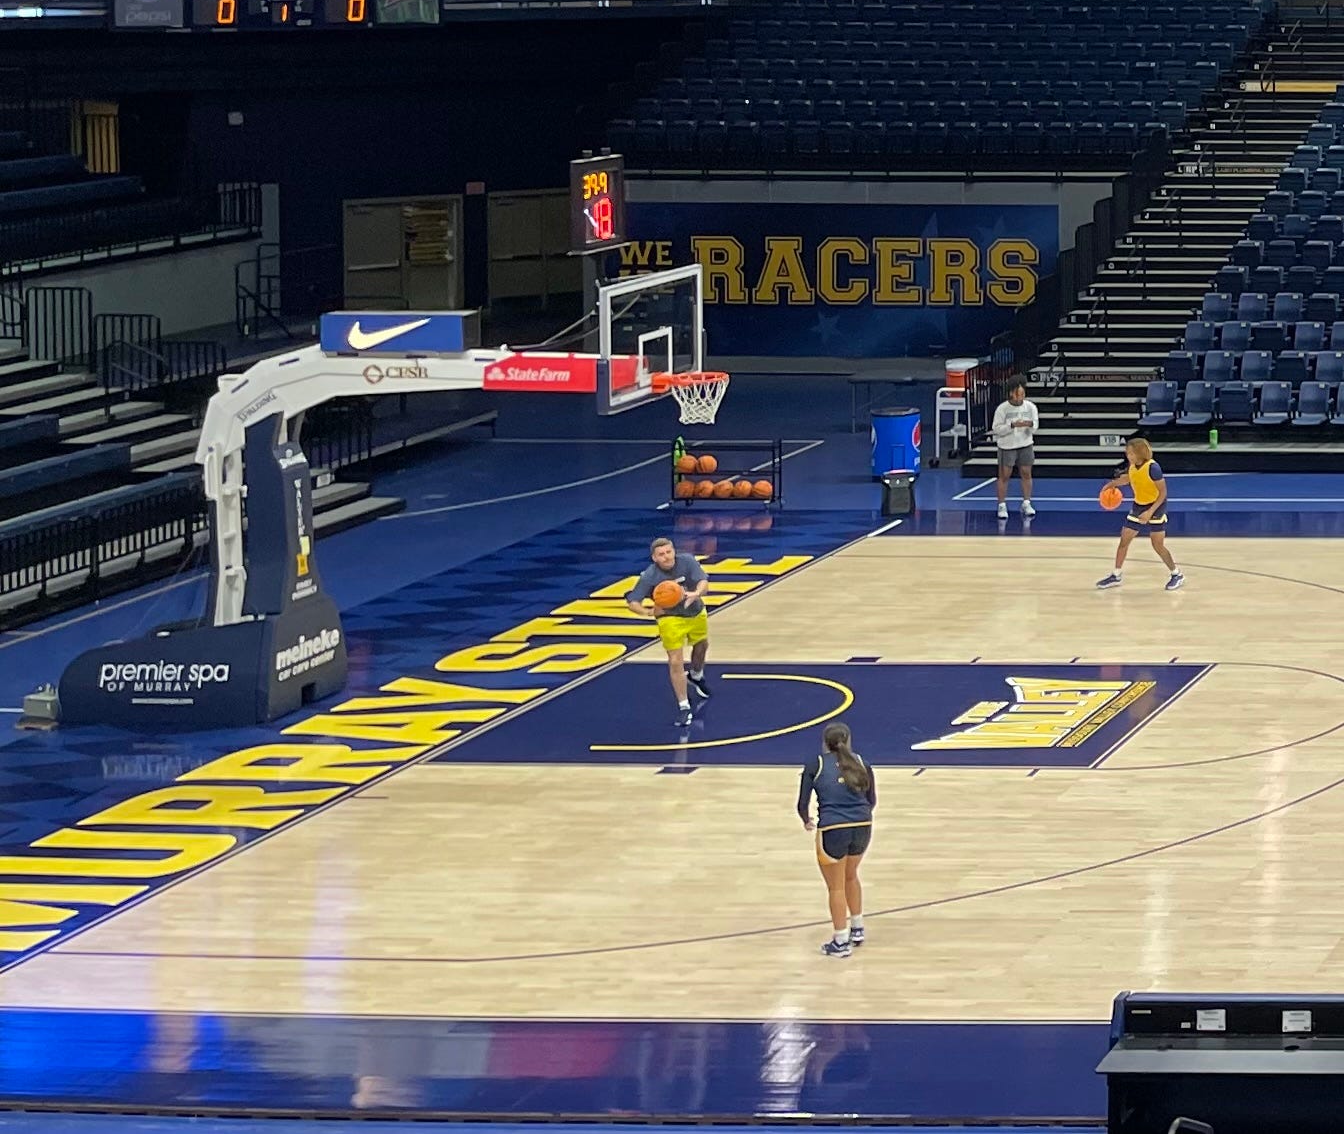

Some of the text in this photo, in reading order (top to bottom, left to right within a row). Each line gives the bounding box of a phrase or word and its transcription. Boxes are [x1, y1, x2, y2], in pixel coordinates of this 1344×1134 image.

[583, 171, 609, 200] 39.9
[619, 241, 673, 266] WE
[691, 235, 1040, 307] RACERS
[385, 366, 429, 380] CFSB
[276, 628, 340, 670] meineke
[100, 660, 230, 689] premier spa
[278, 650, 335, 681] car care center
[107, 682, 191, 692] OF MURRAY
